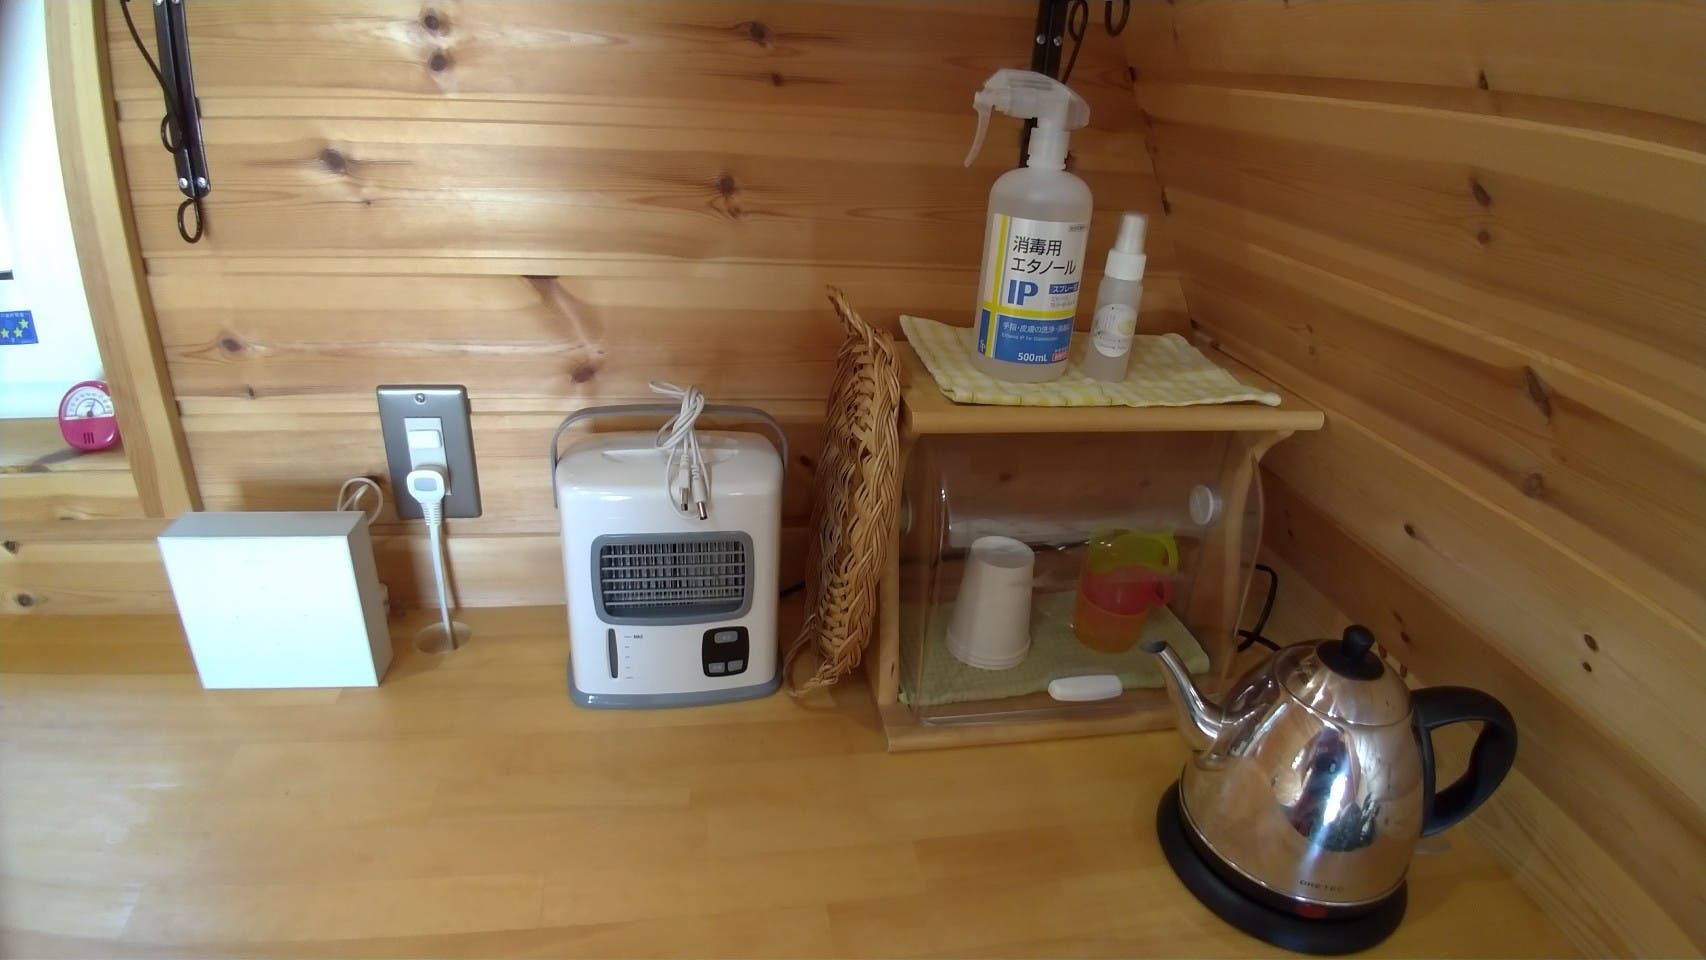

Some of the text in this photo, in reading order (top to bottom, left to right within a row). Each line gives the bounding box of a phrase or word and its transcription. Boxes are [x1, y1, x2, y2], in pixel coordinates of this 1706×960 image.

[1012, 235, 1062, 257] 消毒用
[1011, 257, 1076, 276] エタノール
[1007, 279, 1039, 306] IP
[1017, 352, 1048, 362] 500mL
